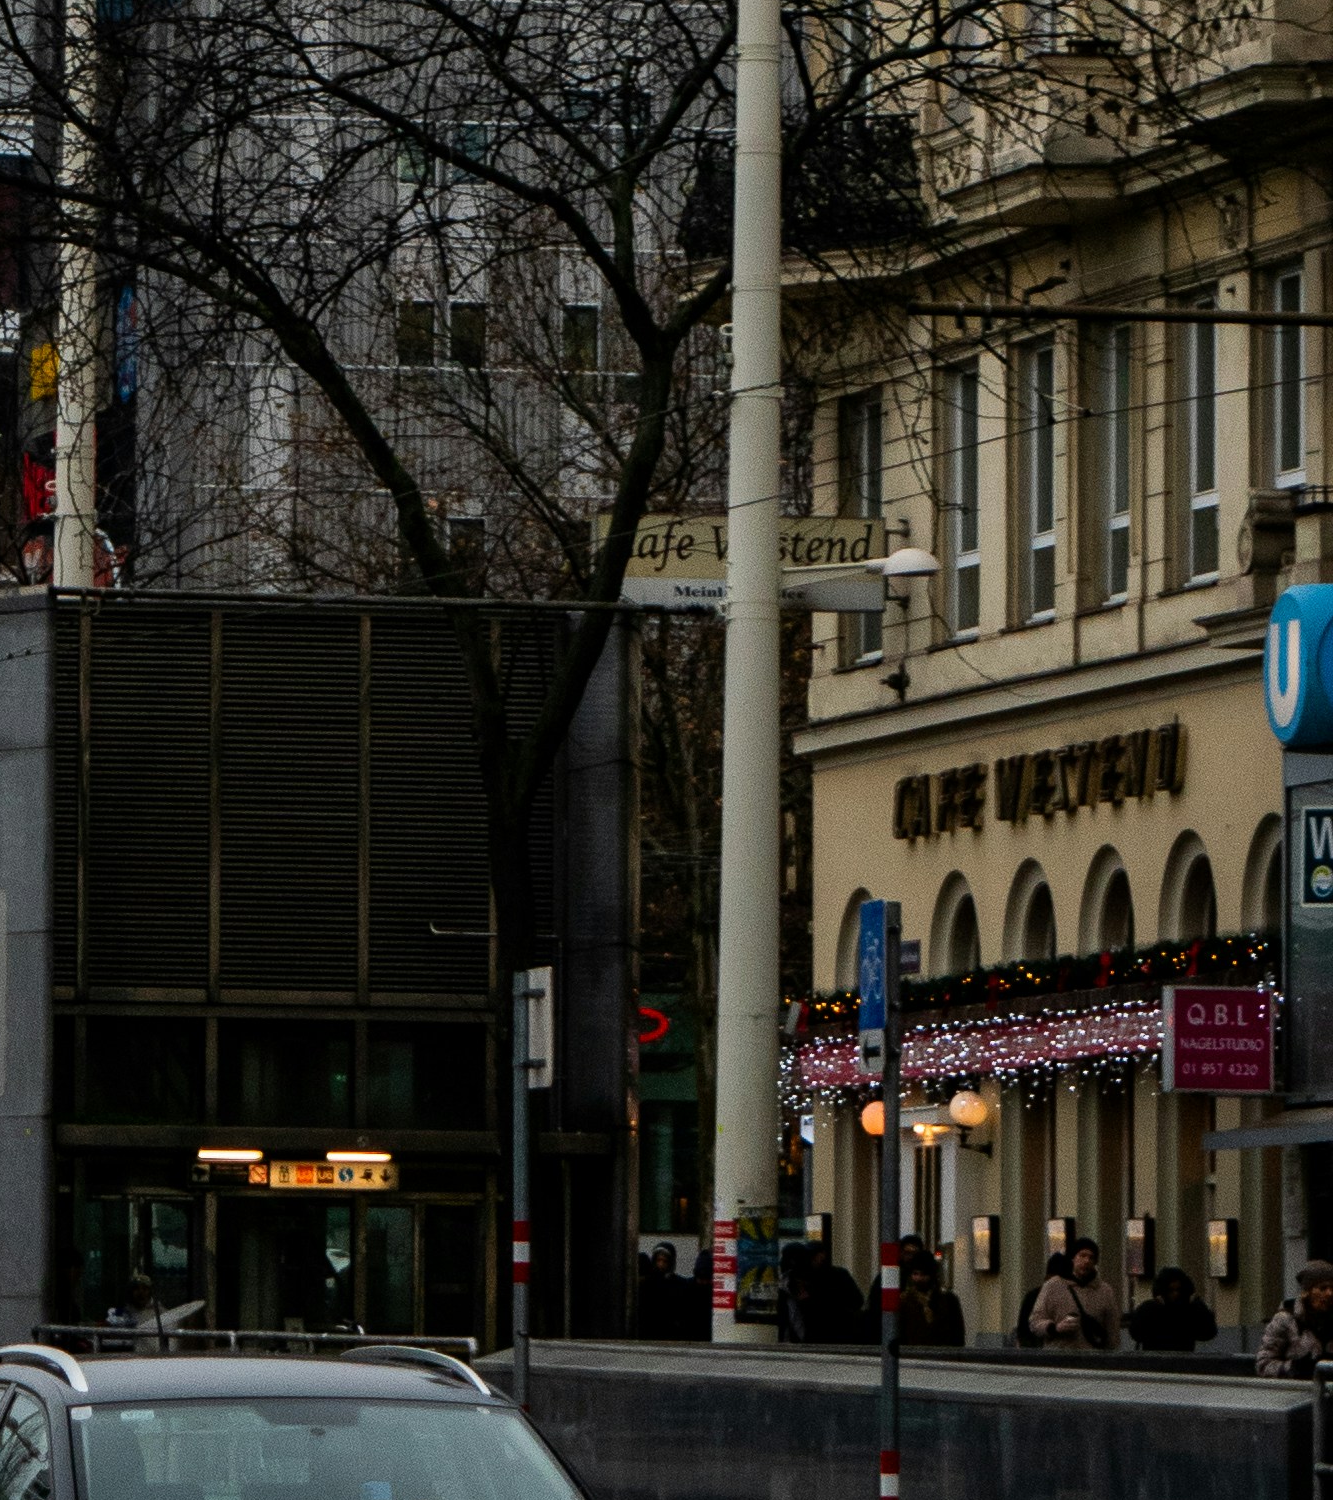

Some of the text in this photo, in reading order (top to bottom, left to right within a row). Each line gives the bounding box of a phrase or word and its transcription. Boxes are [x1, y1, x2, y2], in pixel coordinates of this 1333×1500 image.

[633, 521, 695, 572] afe
[1270, 618, 1302, 729] U
[893, 722, 1184, 840] CAFE WESTEND
[1179, 1037, 1265, 1053] NAGELSTUDIO
